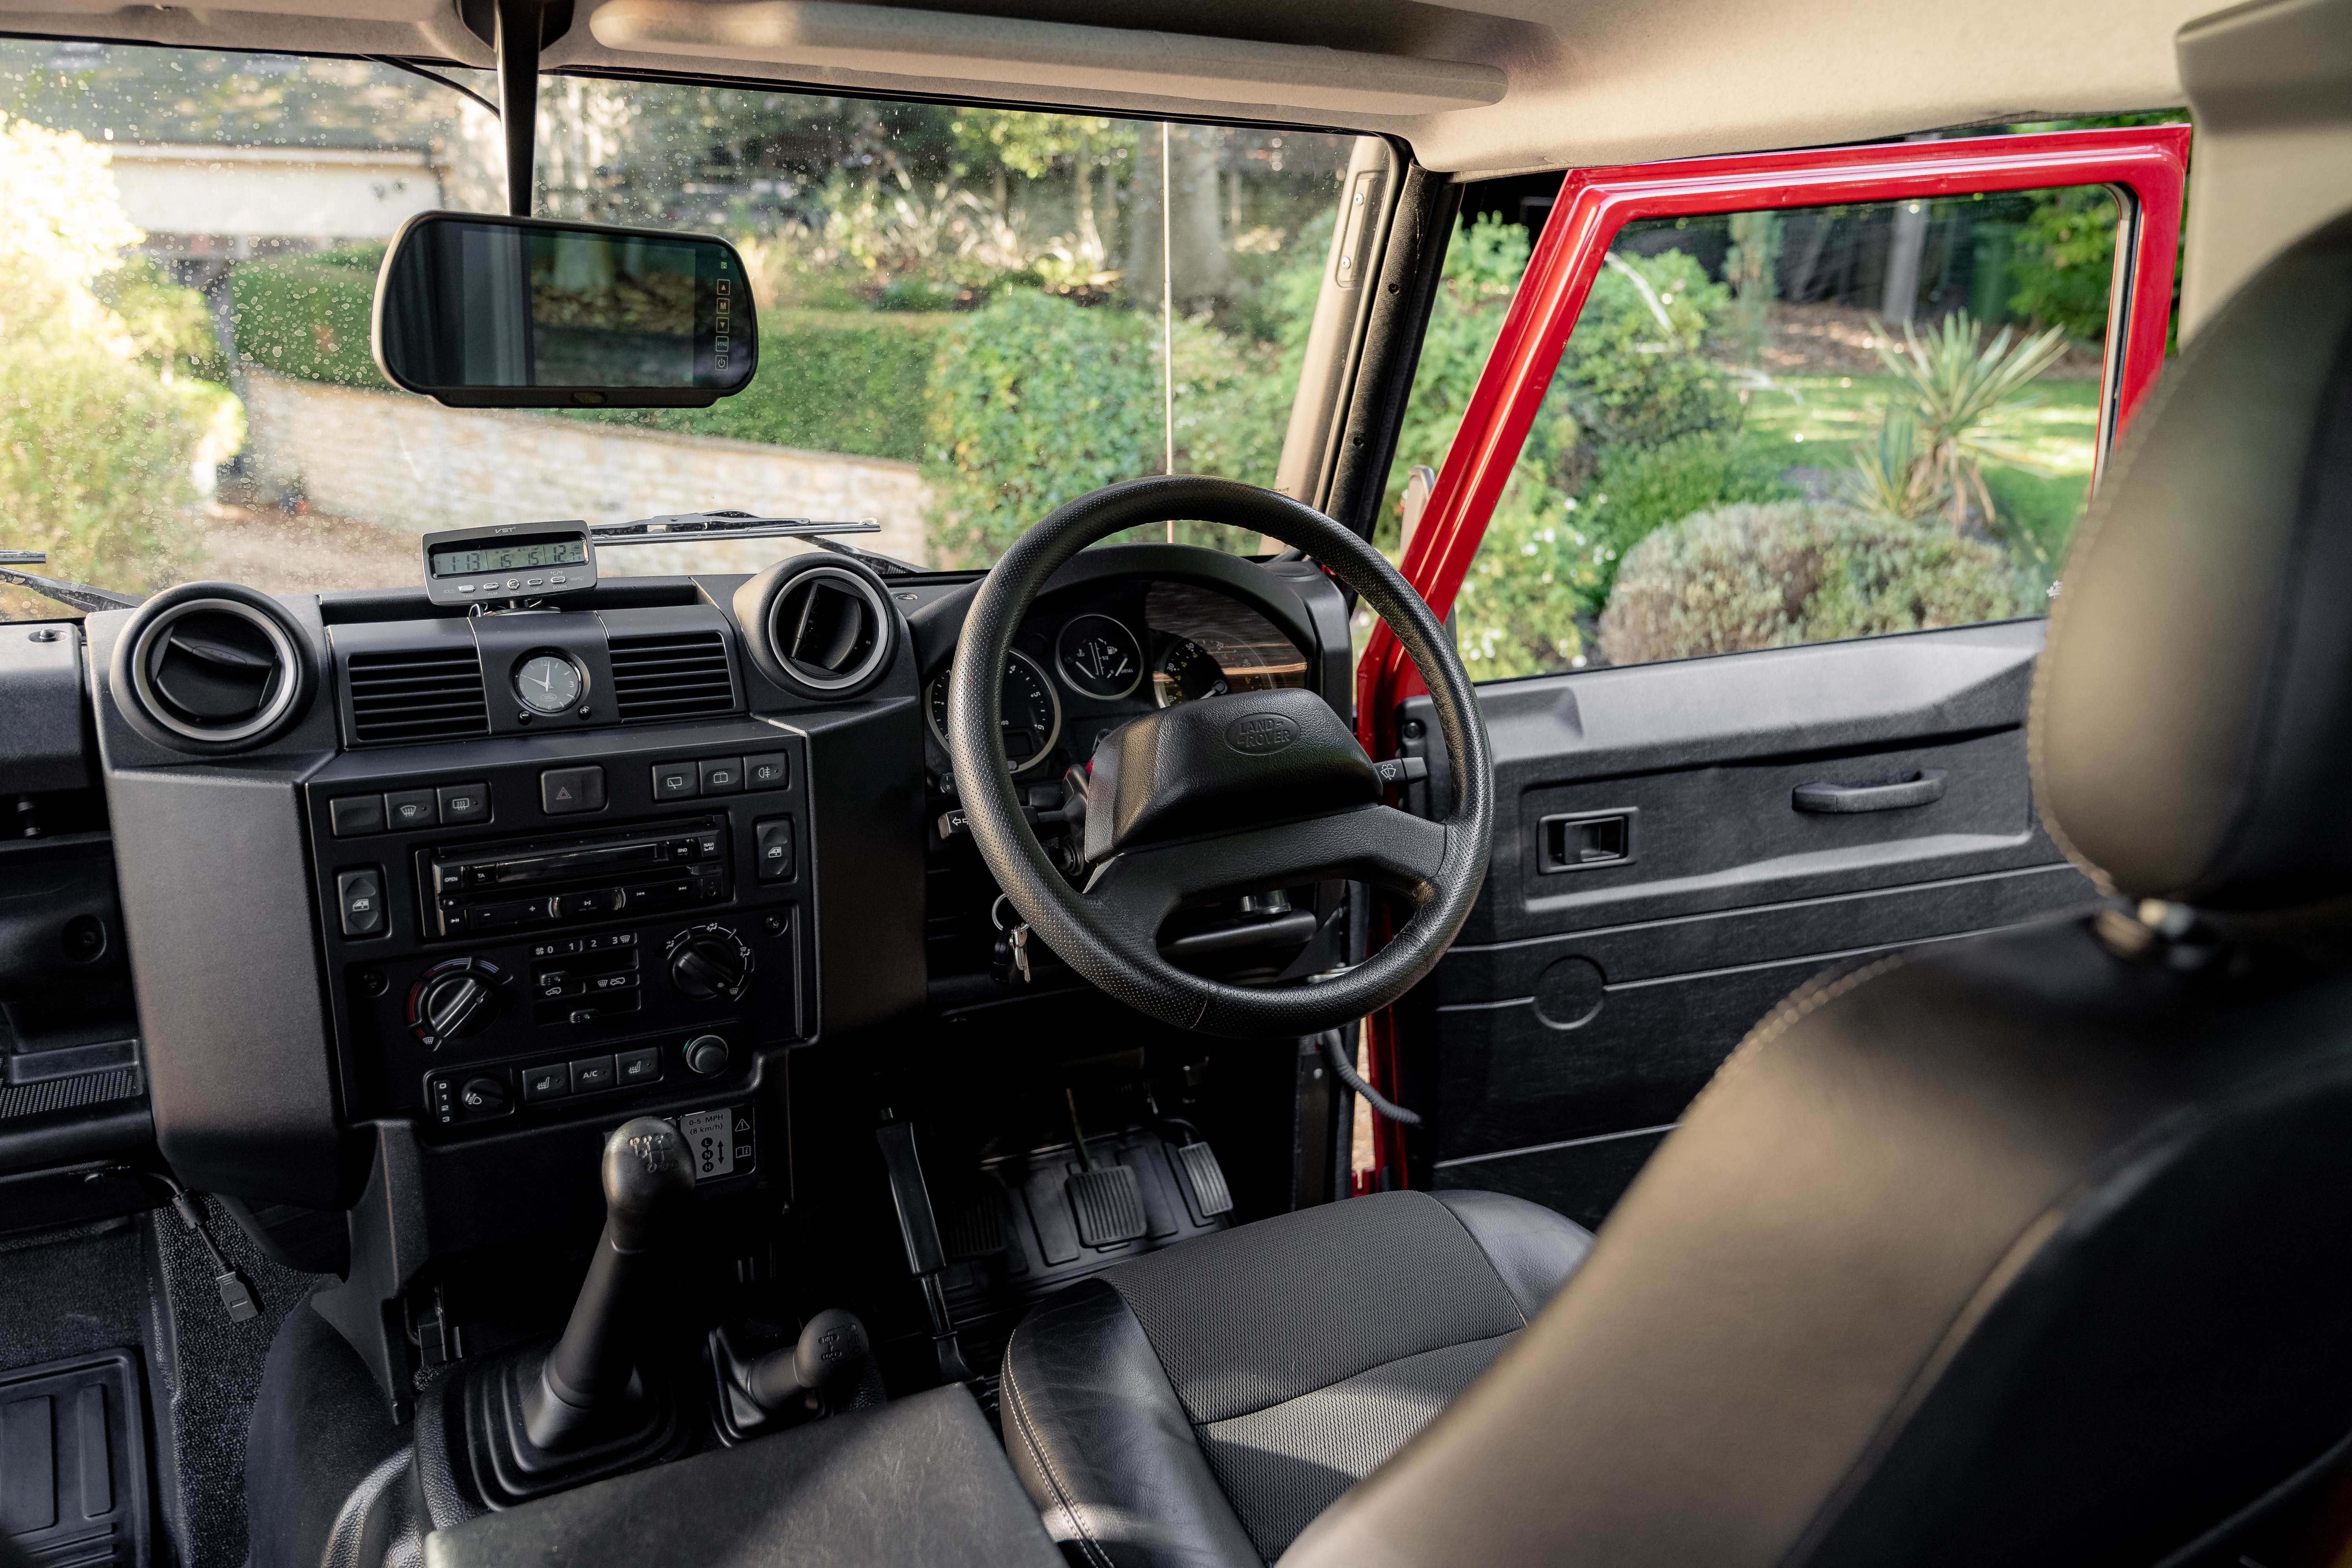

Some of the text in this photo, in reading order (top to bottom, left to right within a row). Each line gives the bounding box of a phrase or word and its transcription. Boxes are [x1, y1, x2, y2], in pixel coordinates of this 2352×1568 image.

[500, 554, 511, 568] 15
[528, 551, 539, 565] 15
[1167, 663, 1175, 672] 30
[705, 1114, 723, 1123] MPH
[700, 1123, 723, 1133] km/h)
